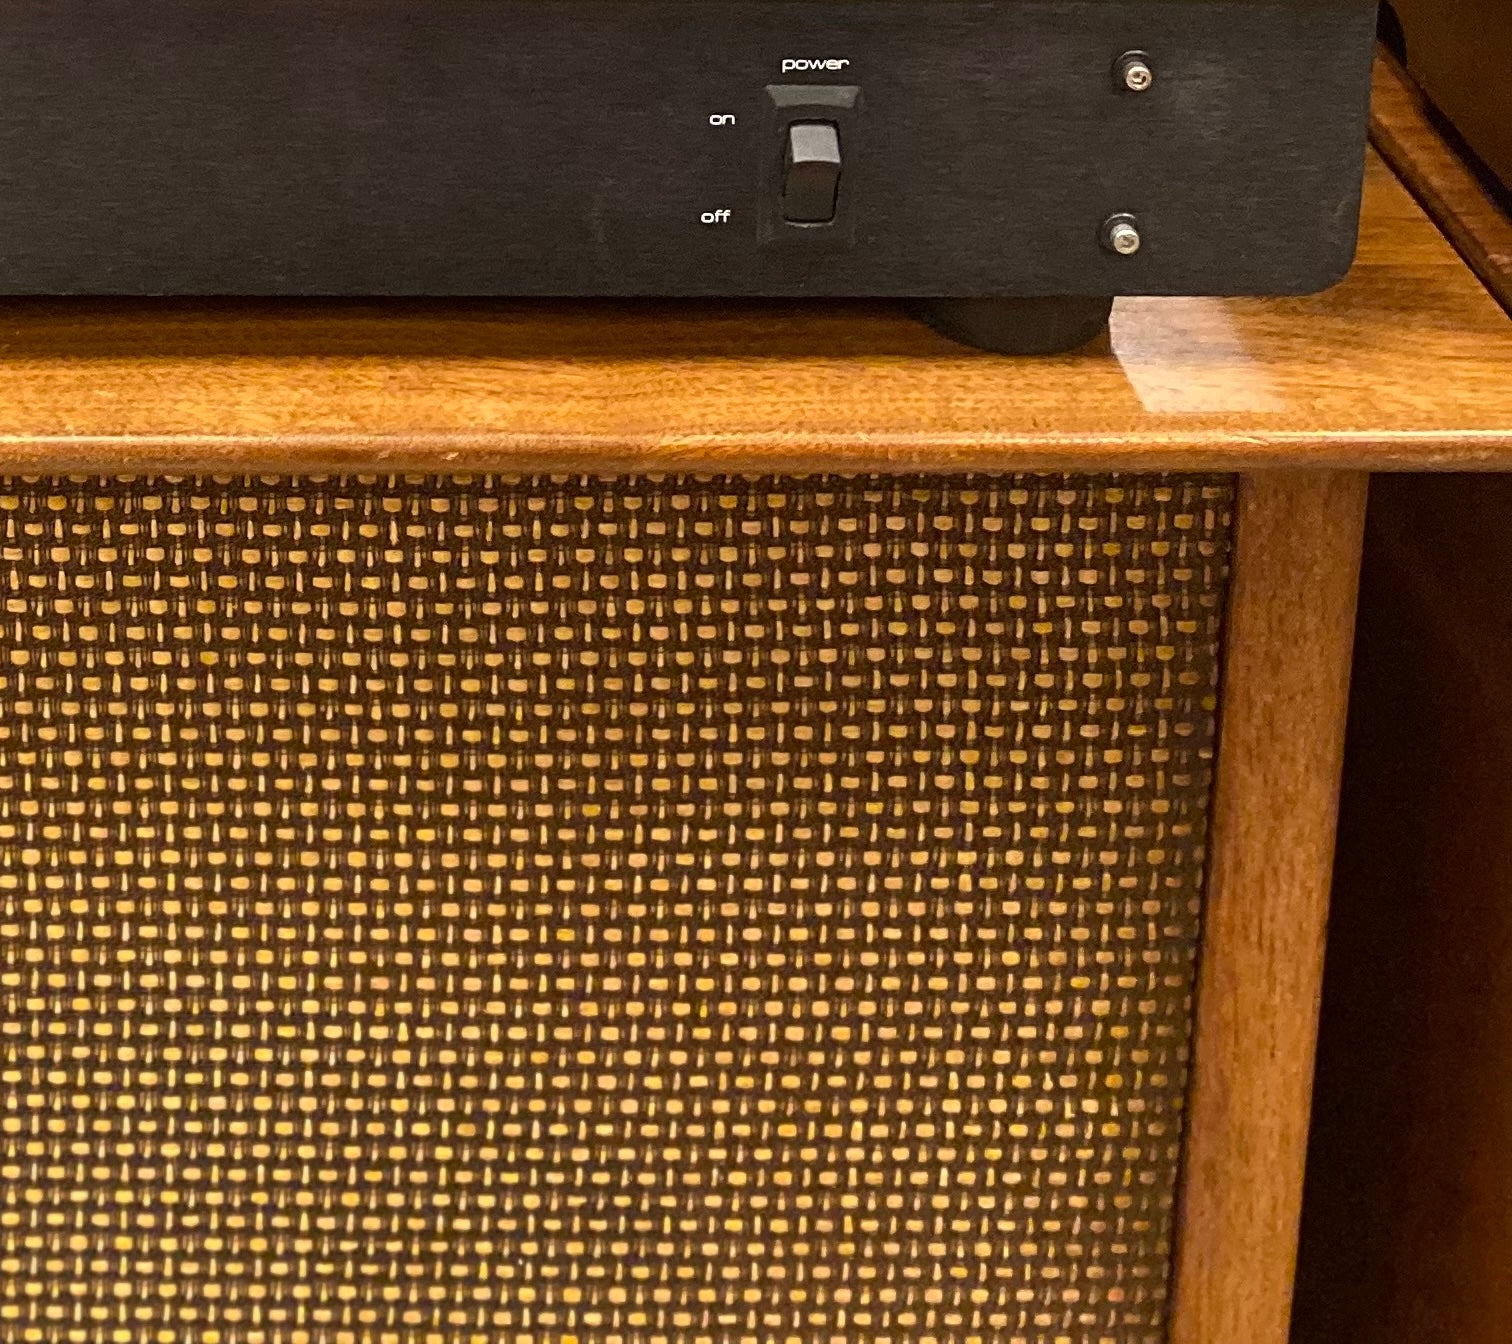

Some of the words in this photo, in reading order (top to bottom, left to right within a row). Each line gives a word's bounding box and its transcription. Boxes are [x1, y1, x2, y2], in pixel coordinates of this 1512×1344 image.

[781, 58, 850, 74] power
[709, 114, 736, 126] on
[700, 209, 731, 224] off
